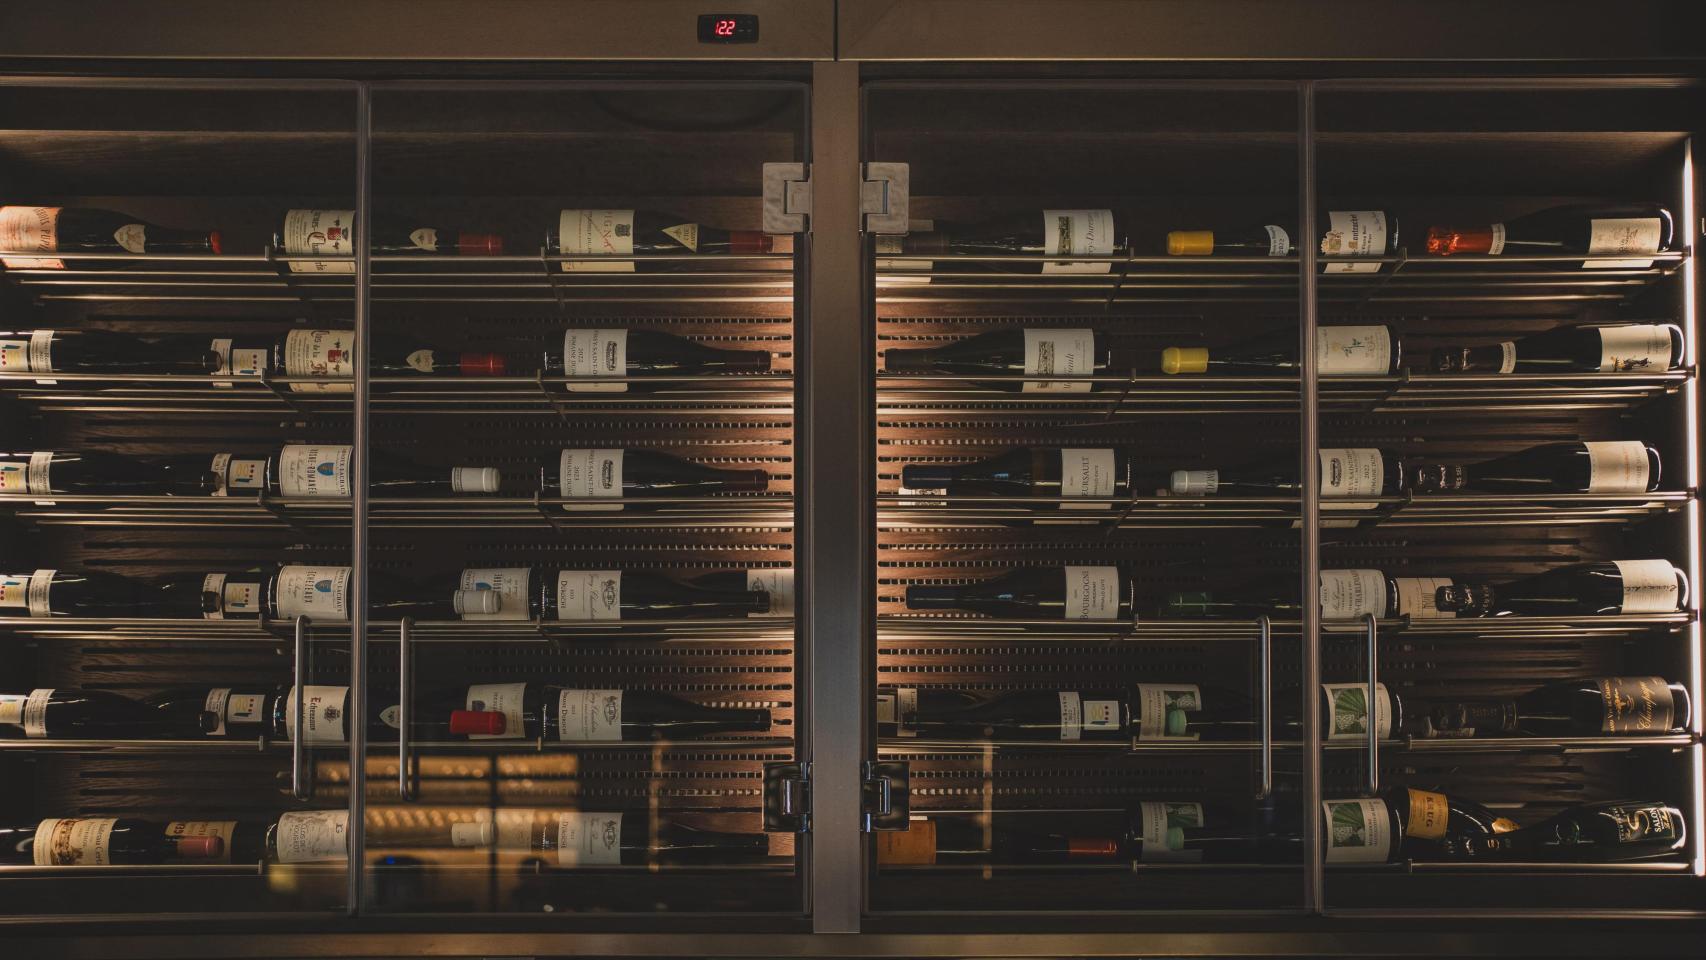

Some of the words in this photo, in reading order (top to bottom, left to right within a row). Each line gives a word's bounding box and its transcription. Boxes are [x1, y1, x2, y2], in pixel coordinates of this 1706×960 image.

[715, 20, 735, 35] 12.2
[1080, 570, 1090, 620] BOURGOGNE
[1424, 796, 1435, 828] KRUG
[1650, 808, 1663, 833] SALON
